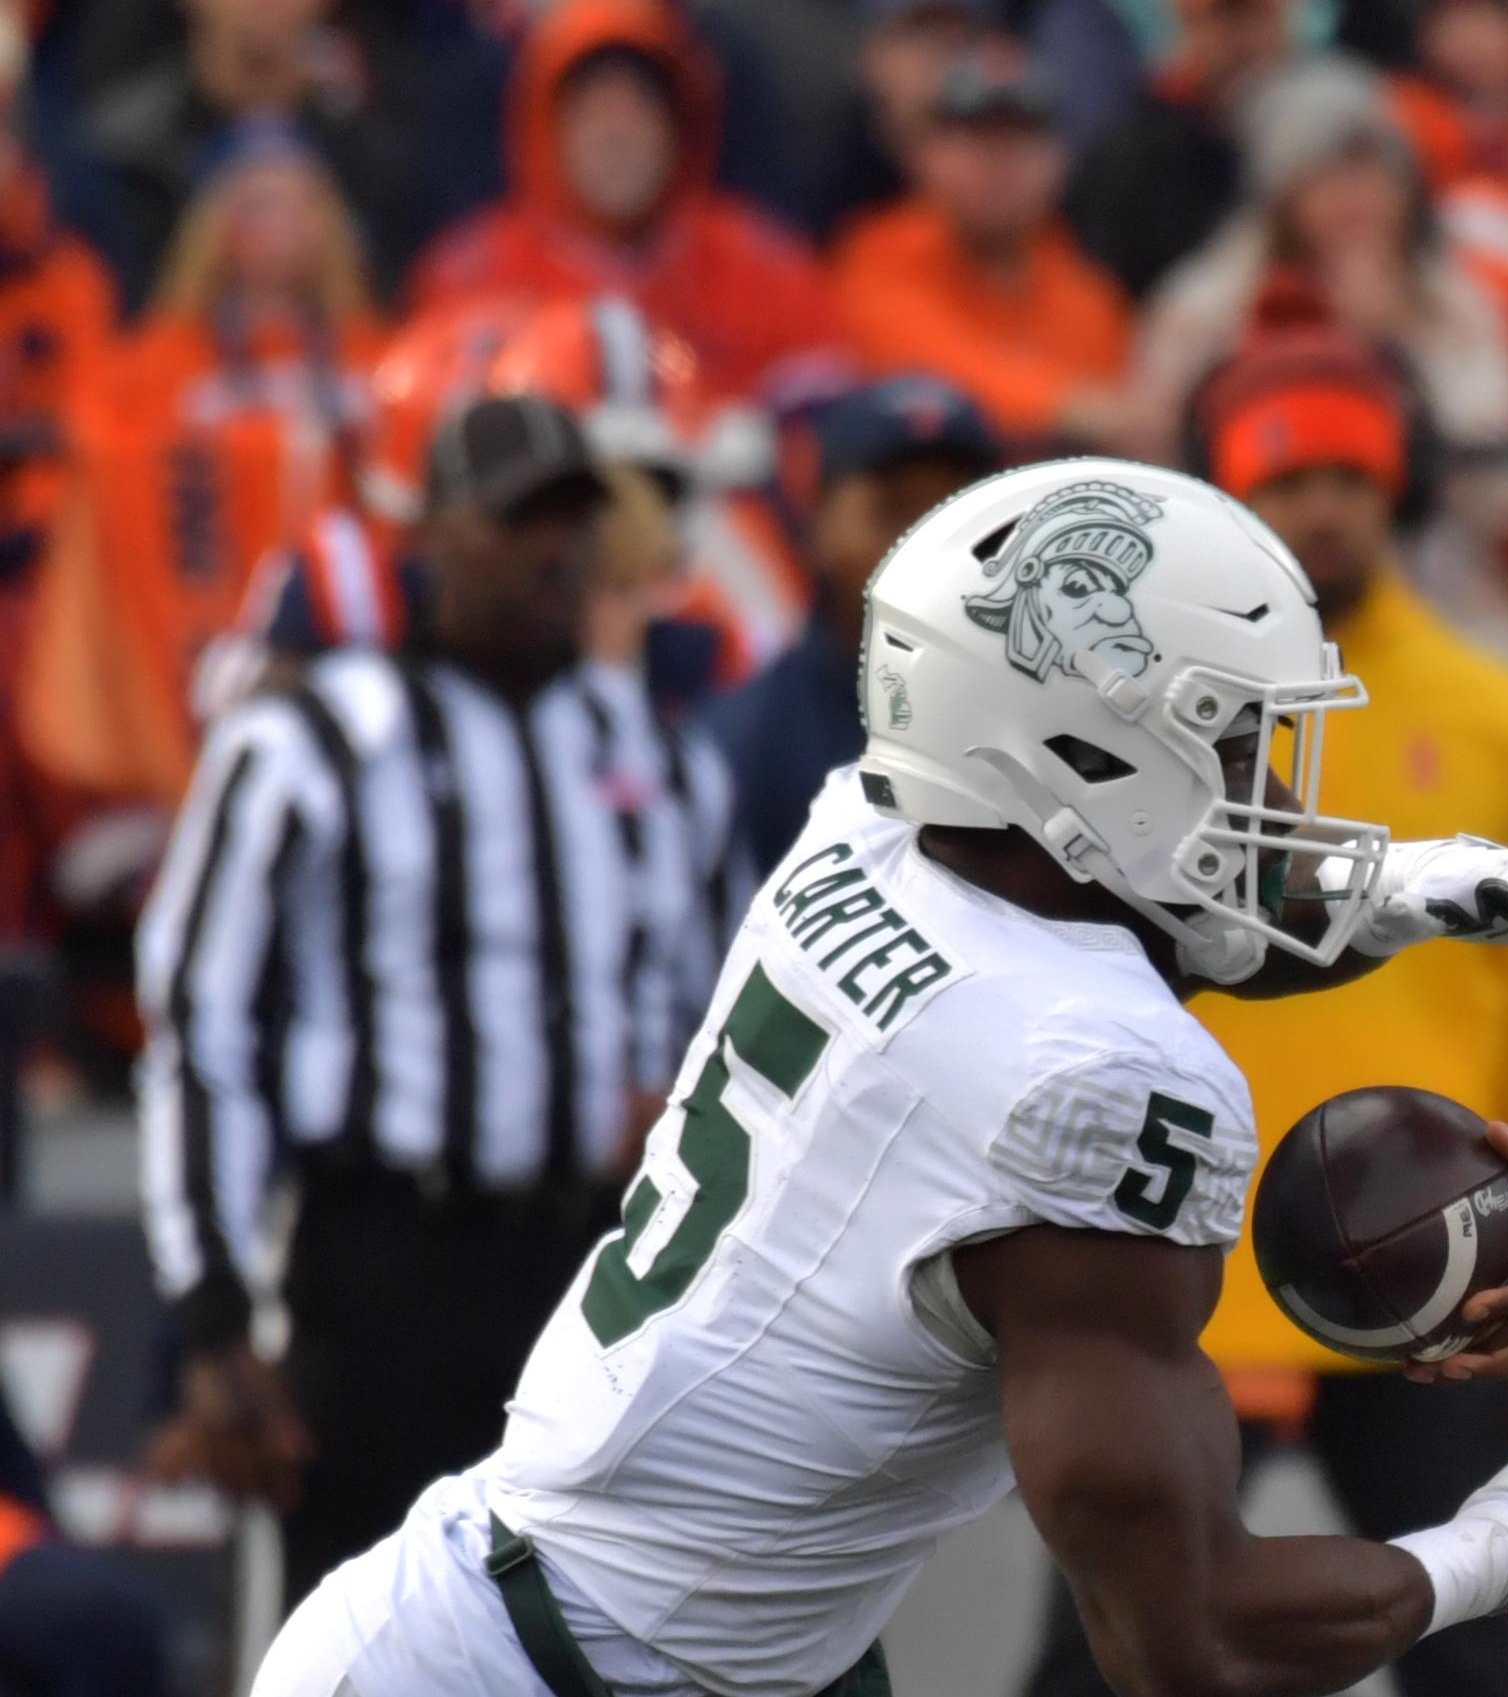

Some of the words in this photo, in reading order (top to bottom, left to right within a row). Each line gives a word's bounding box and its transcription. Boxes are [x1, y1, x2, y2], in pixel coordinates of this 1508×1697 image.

[773, 842, 953, 1033] CARTER
[580, 958, 831, 1349] 5
[1113, 1090, 1215, 1230] 5
